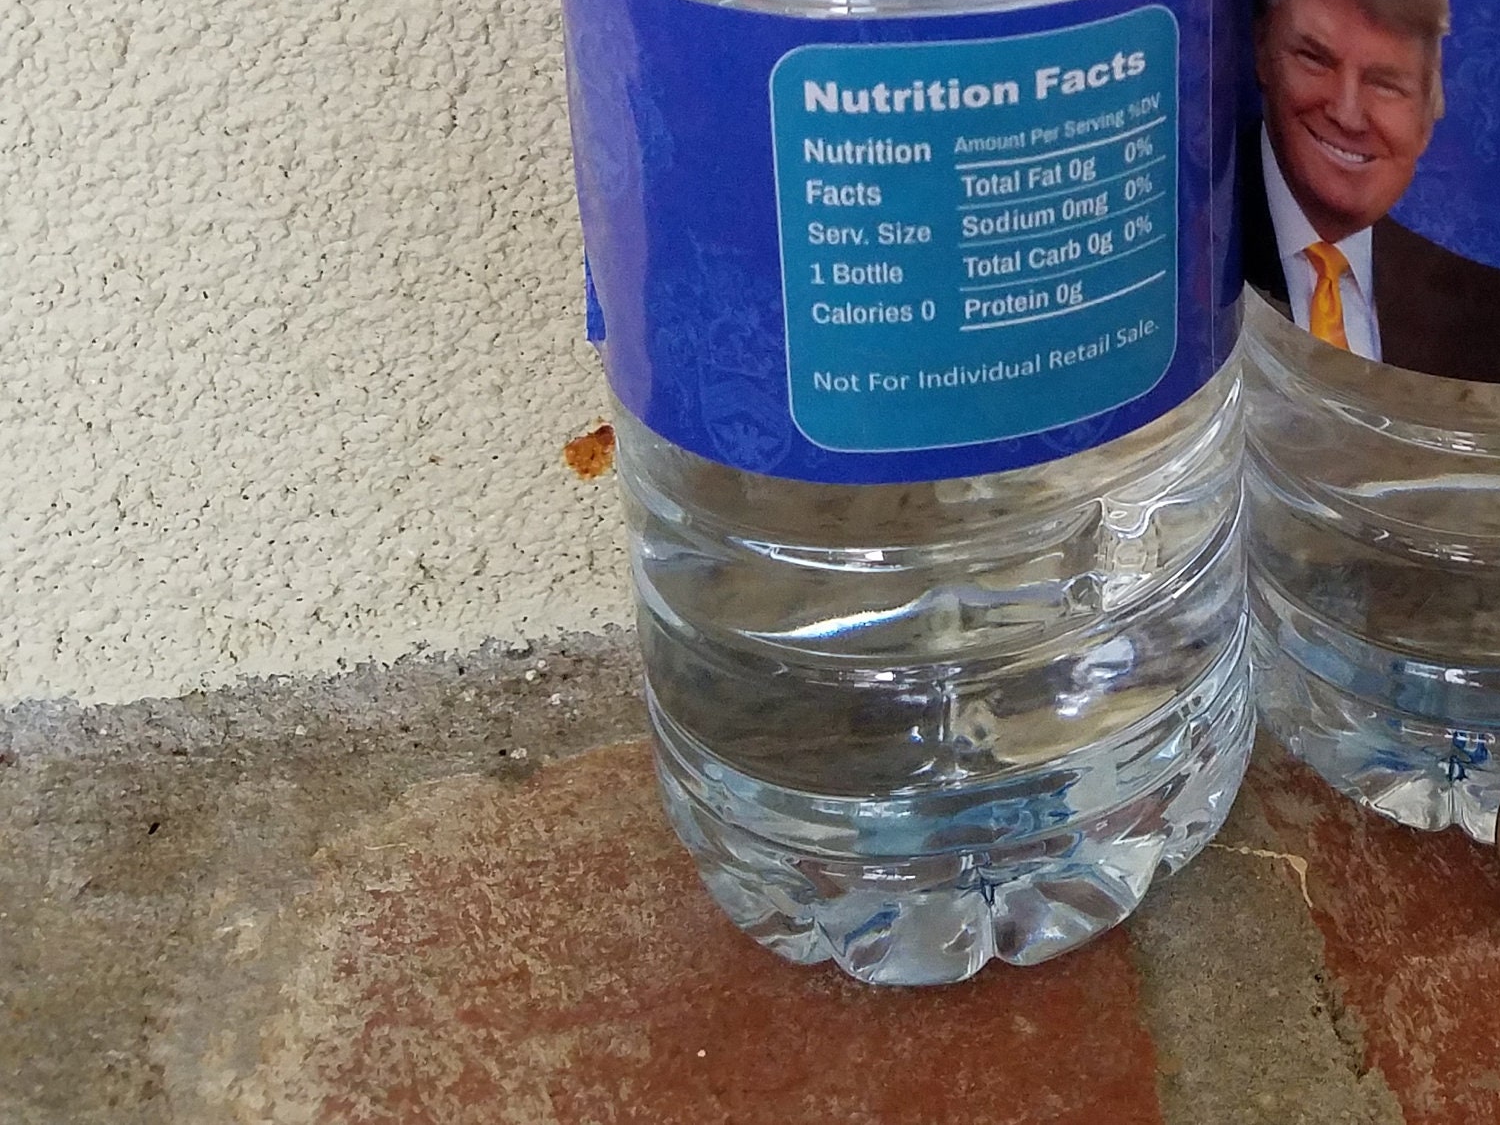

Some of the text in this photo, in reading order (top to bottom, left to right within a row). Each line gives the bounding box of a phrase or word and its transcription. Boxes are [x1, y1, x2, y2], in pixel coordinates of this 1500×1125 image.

[803, 48, 1146, 114] Nutrition Facts
[954, 93, 1161, 155] Amount Per Serving %DV
[803, 137, 932, 165] Nutrition
[961, 139, 1153, 198] Total Fat 0g 0%
[805, 179, 882, 207] Facts
[961, 174, 1153, 238] Sodium 0mg 0%
[807, 221, 932, 246] Serv. Size
[963, 215, 1153, 279] Total Carb 0g 0%
[810, 262, 903, 285] 1 Bottle
[811, 299, 935, 325] Calories 0
[964, 280, 1084, 320] Protein 0g
[813, 318, 1160, 392] Not For Individual Retail Sale.
